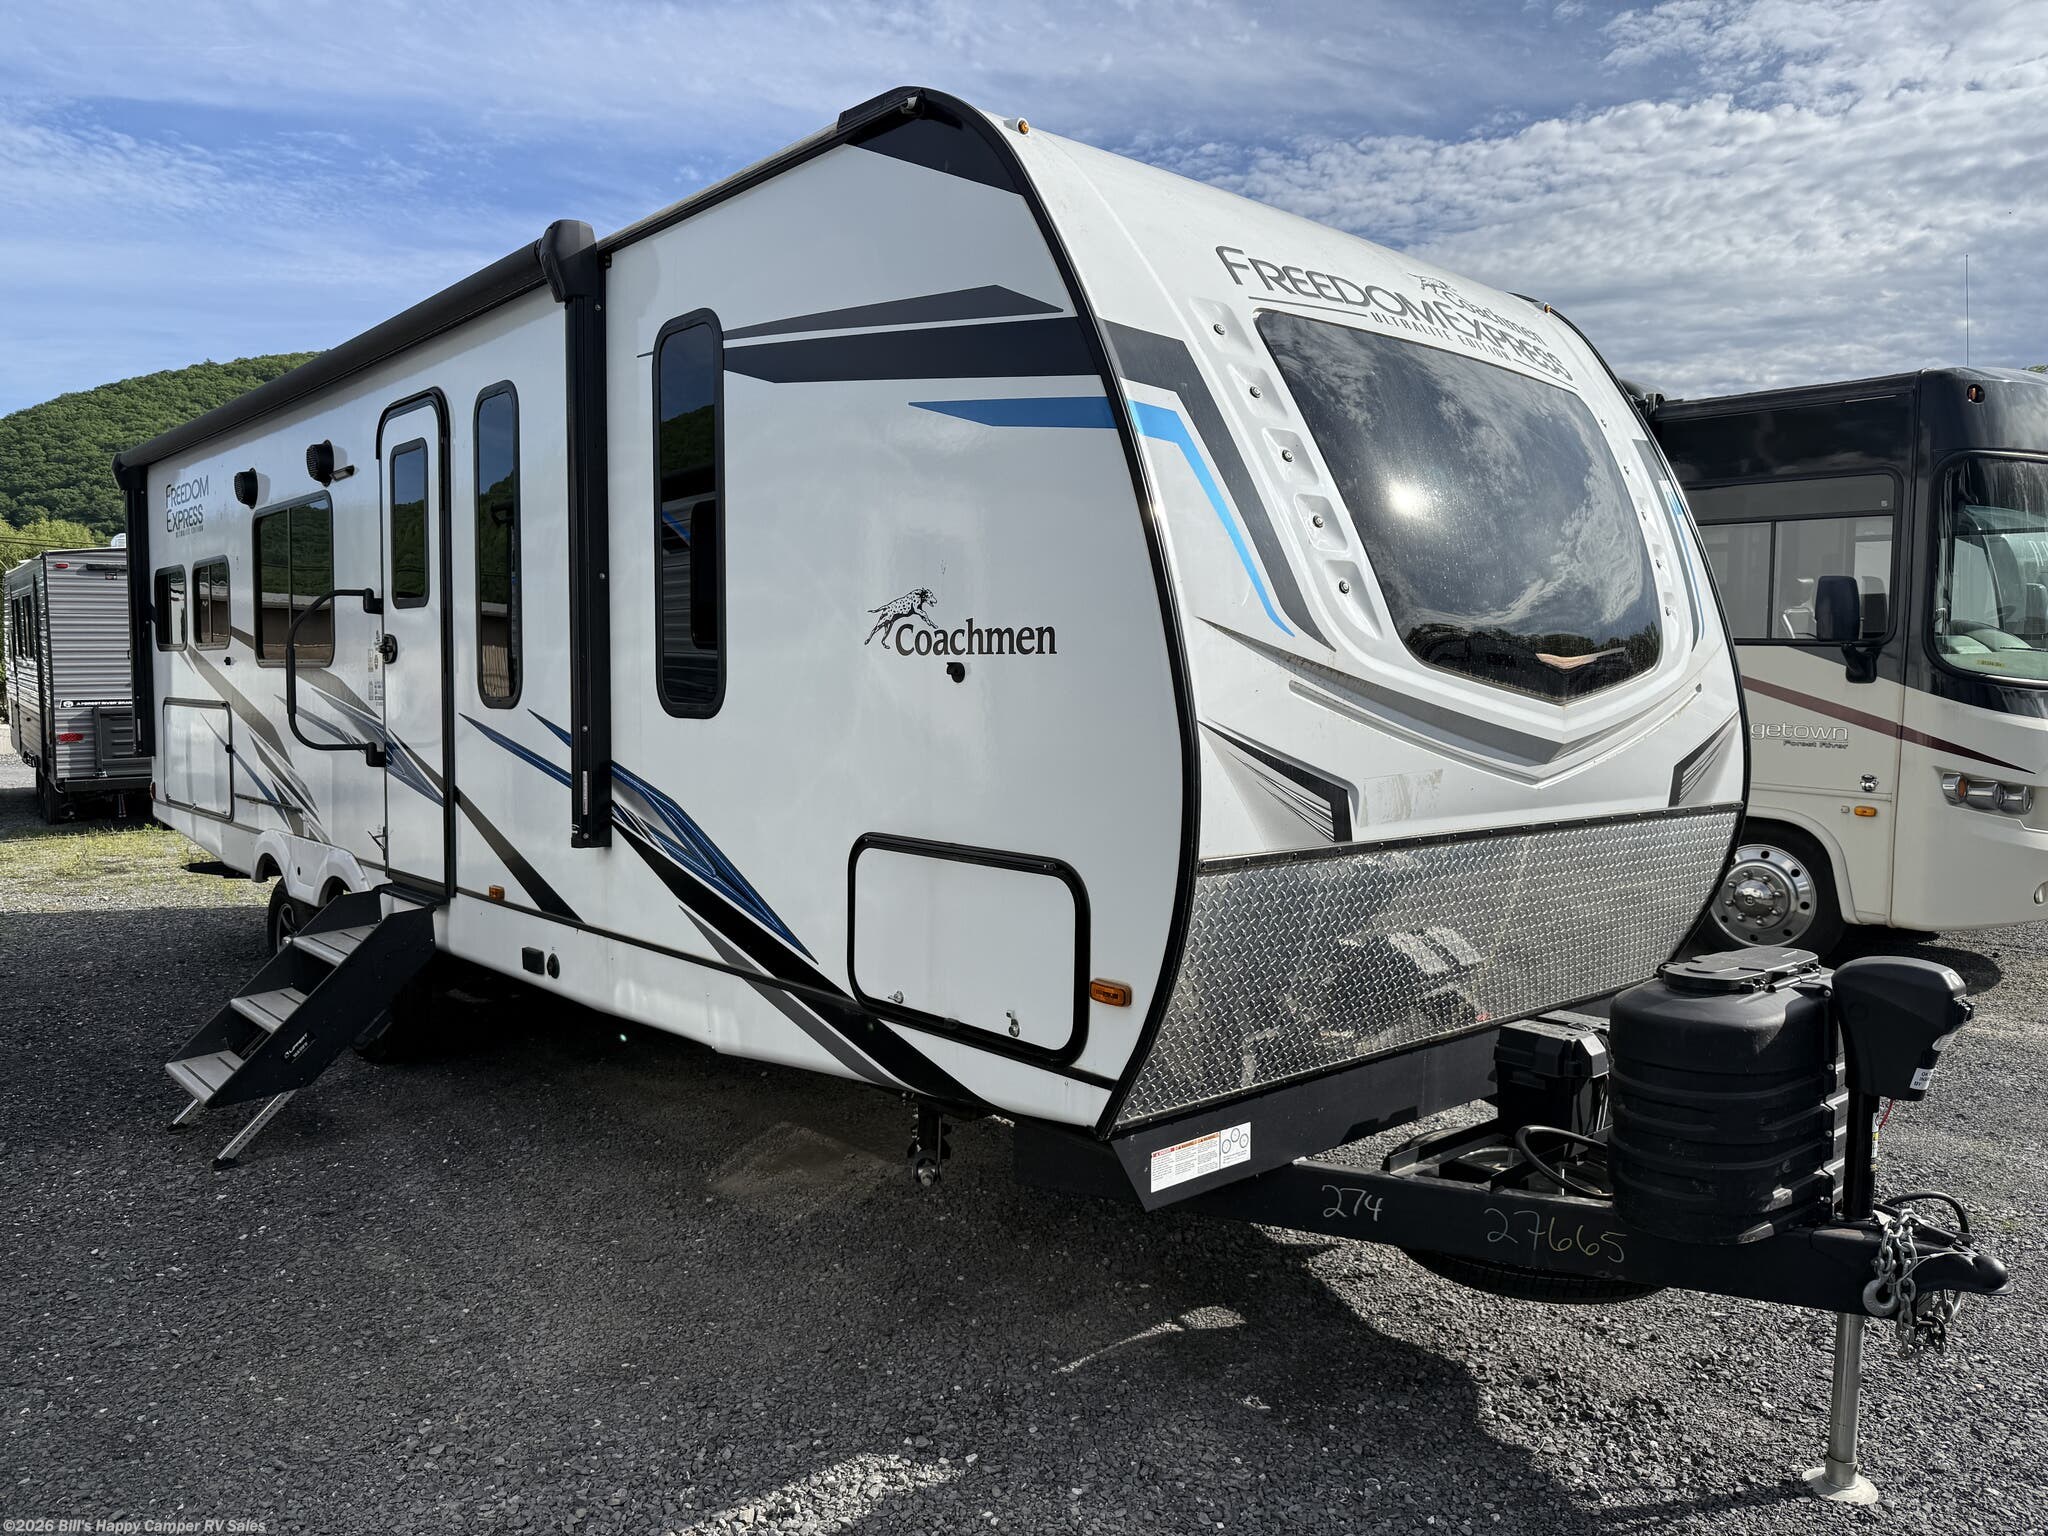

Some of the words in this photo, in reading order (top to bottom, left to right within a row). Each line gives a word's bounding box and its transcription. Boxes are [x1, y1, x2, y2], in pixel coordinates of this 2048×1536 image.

[1371, 311, 1453, 341] ULTRALITE
[1457, 334, 1512, 362] EDITION
[1442, 290, 1549, 347] Coachmen
[166, 475, 209, 508] FREEDOM
[166, 504, 204, 532] EXPRESS
[895, 617, 1057, 656] Coachmen
[1751, 722, 1848, 741] getown
[1783, 740, 1816, 748] Forest
[1819, 741, 1848, 749] River
[1321, 1184, 1384, 1221] 274
[1484, 1208, 1627, 1263] 27665
